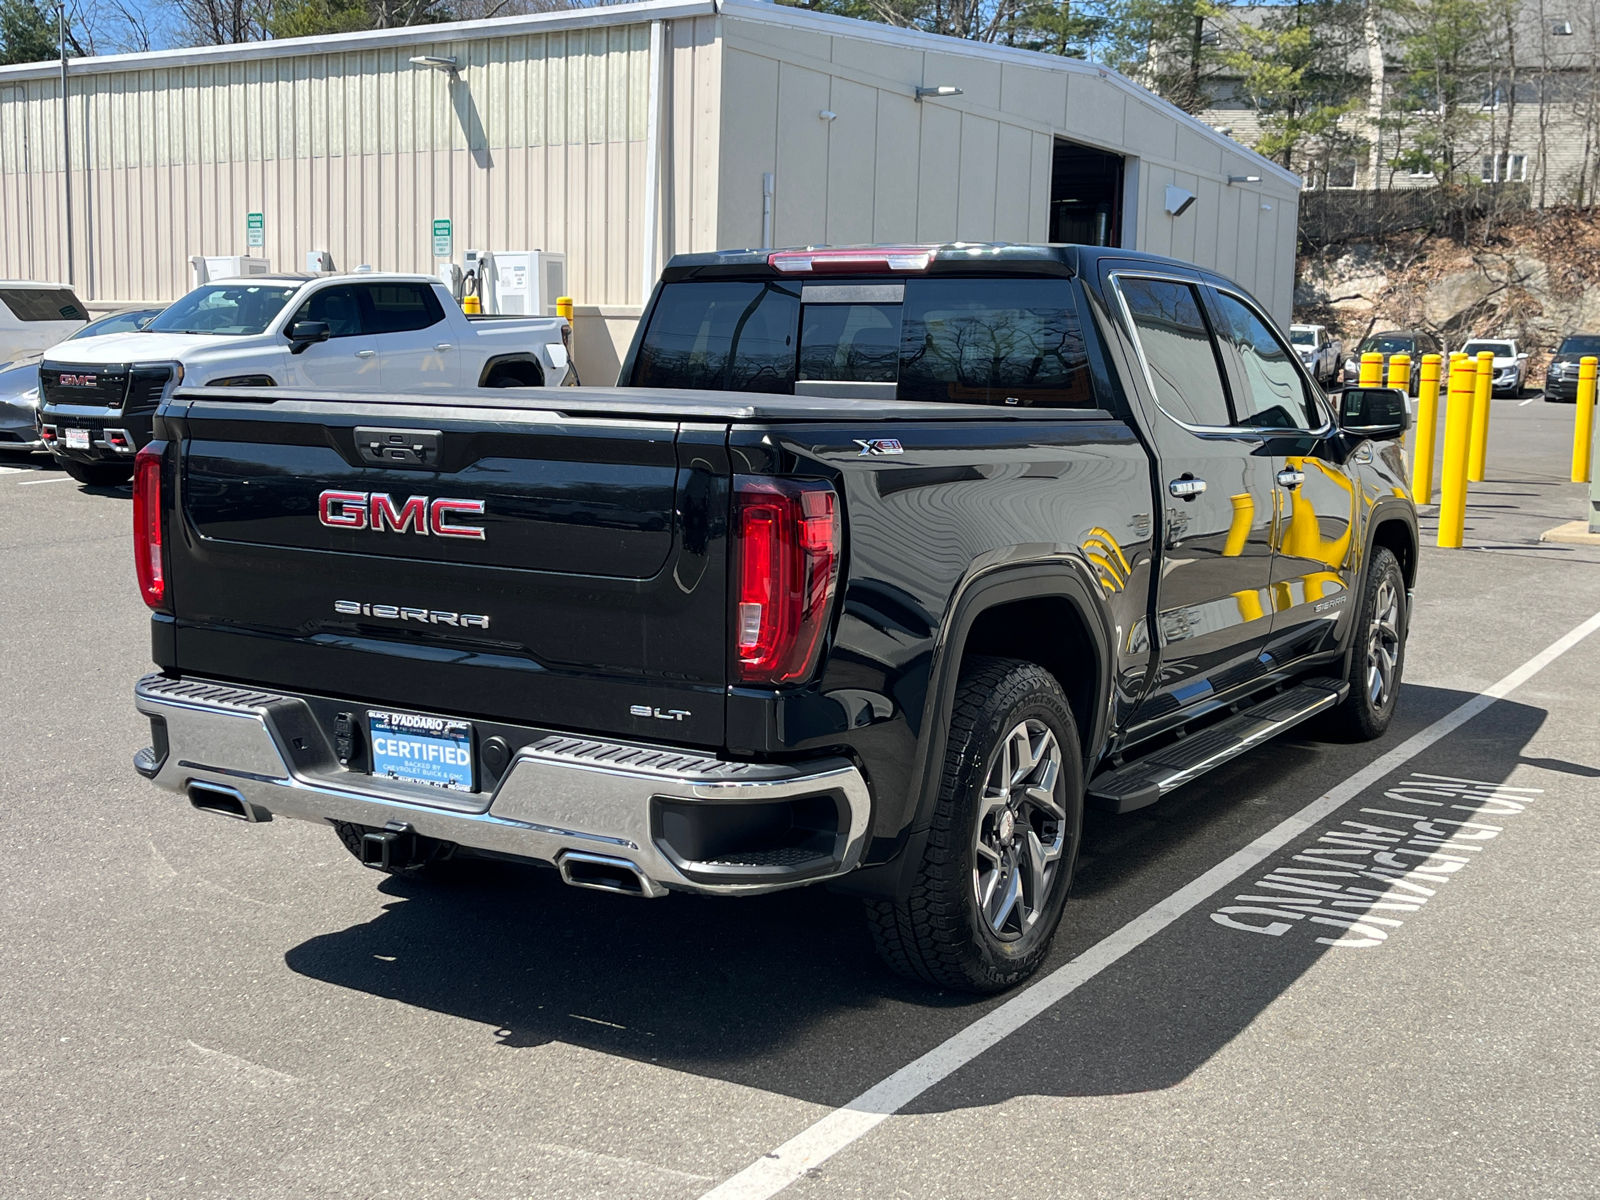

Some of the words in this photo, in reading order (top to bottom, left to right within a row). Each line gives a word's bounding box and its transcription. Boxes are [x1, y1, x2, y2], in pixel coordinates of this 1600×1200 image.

[60, 374, 97, 387] GMC
[318, 489, 486, 541] GMC
[1313, 595, 1347, 613] SIERRA
[334, 600, 490, 629] SIERRA
[368, 711, 389, 719] BUICK
[391, 714, 443, 730] D'ADDARIO
[630, 704, 692, 721] SLT
[374, 738, 470, 766] CERTIFIED
[382, 763, 421, 774] CHEVROLET
[422, 769, 442, 777] BUICK
[448, 773, 464, 781] GMC
[404, 760, 431, 770] BACKED
[1383, 772, 1545, 815] NO
[1209, 806, 1505, 948] PARKING
